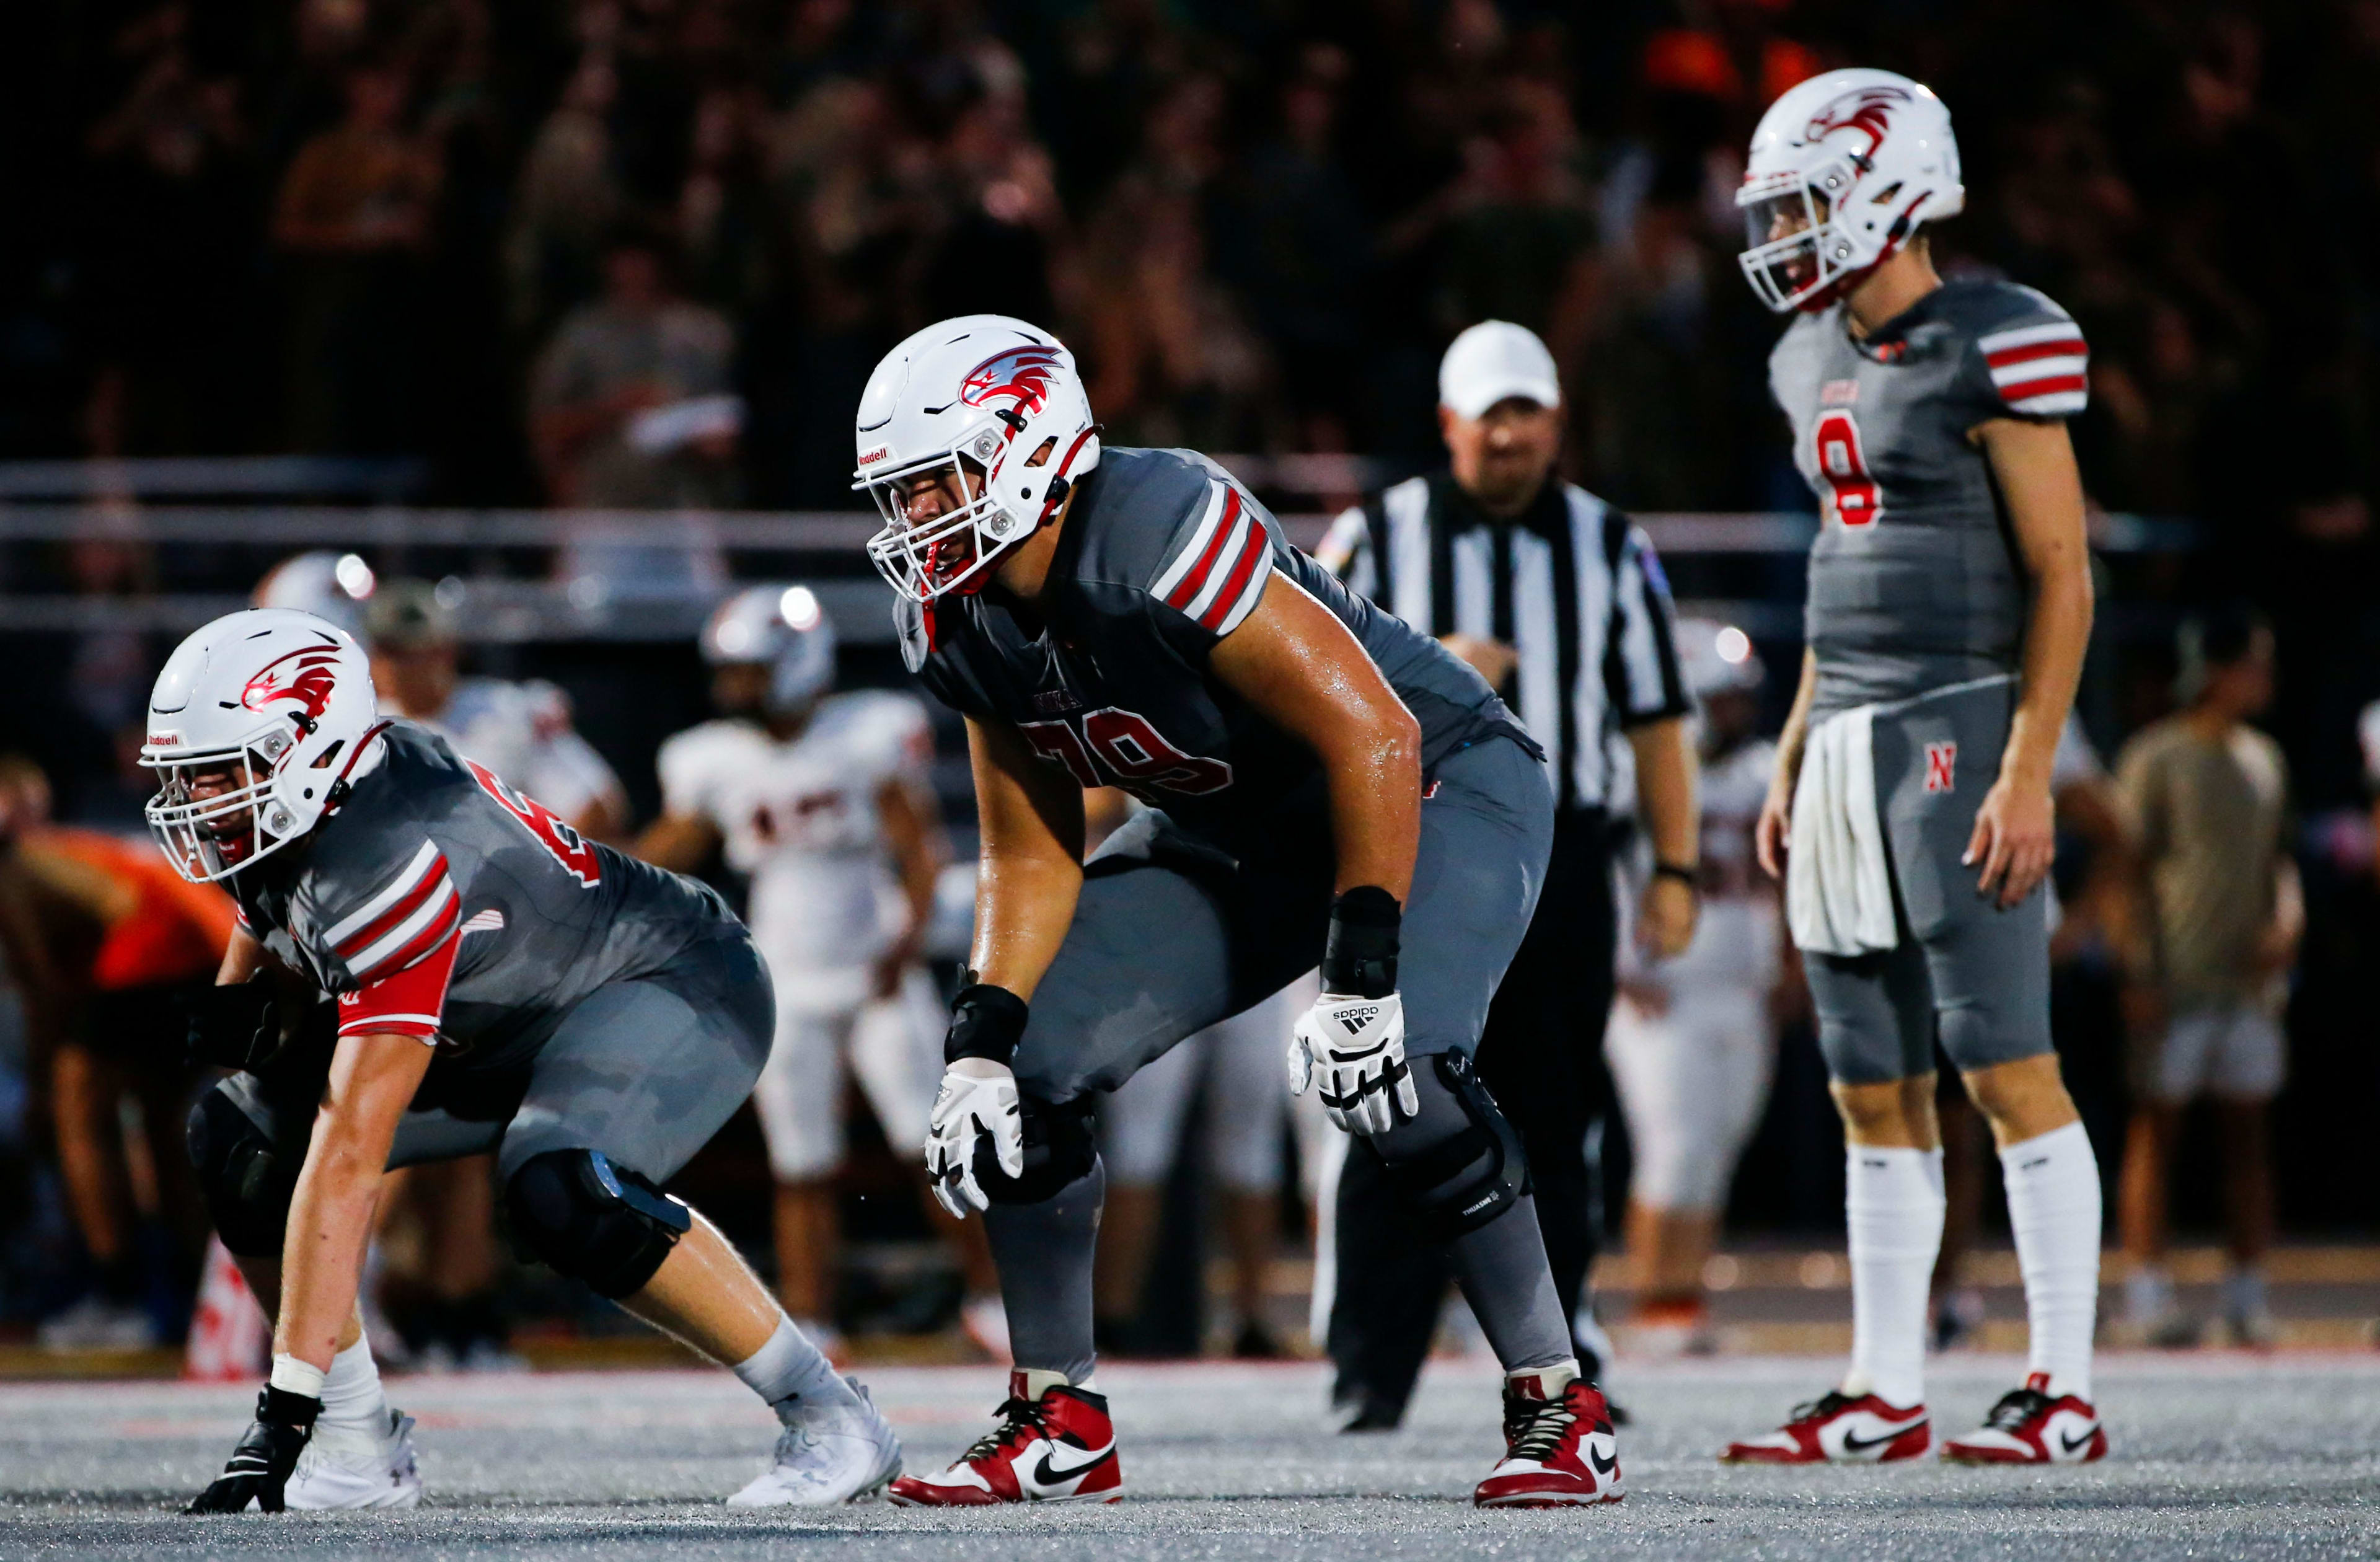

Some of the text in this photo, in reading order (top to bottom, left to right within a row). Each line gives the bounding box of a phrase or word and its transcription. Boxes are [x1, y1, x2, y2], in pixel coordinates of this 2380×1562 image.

[1016, 706, 1233, 801] 79
[1923, 741, 1957, 794] N
[1333, 1007, 1378, 1019] adidas
